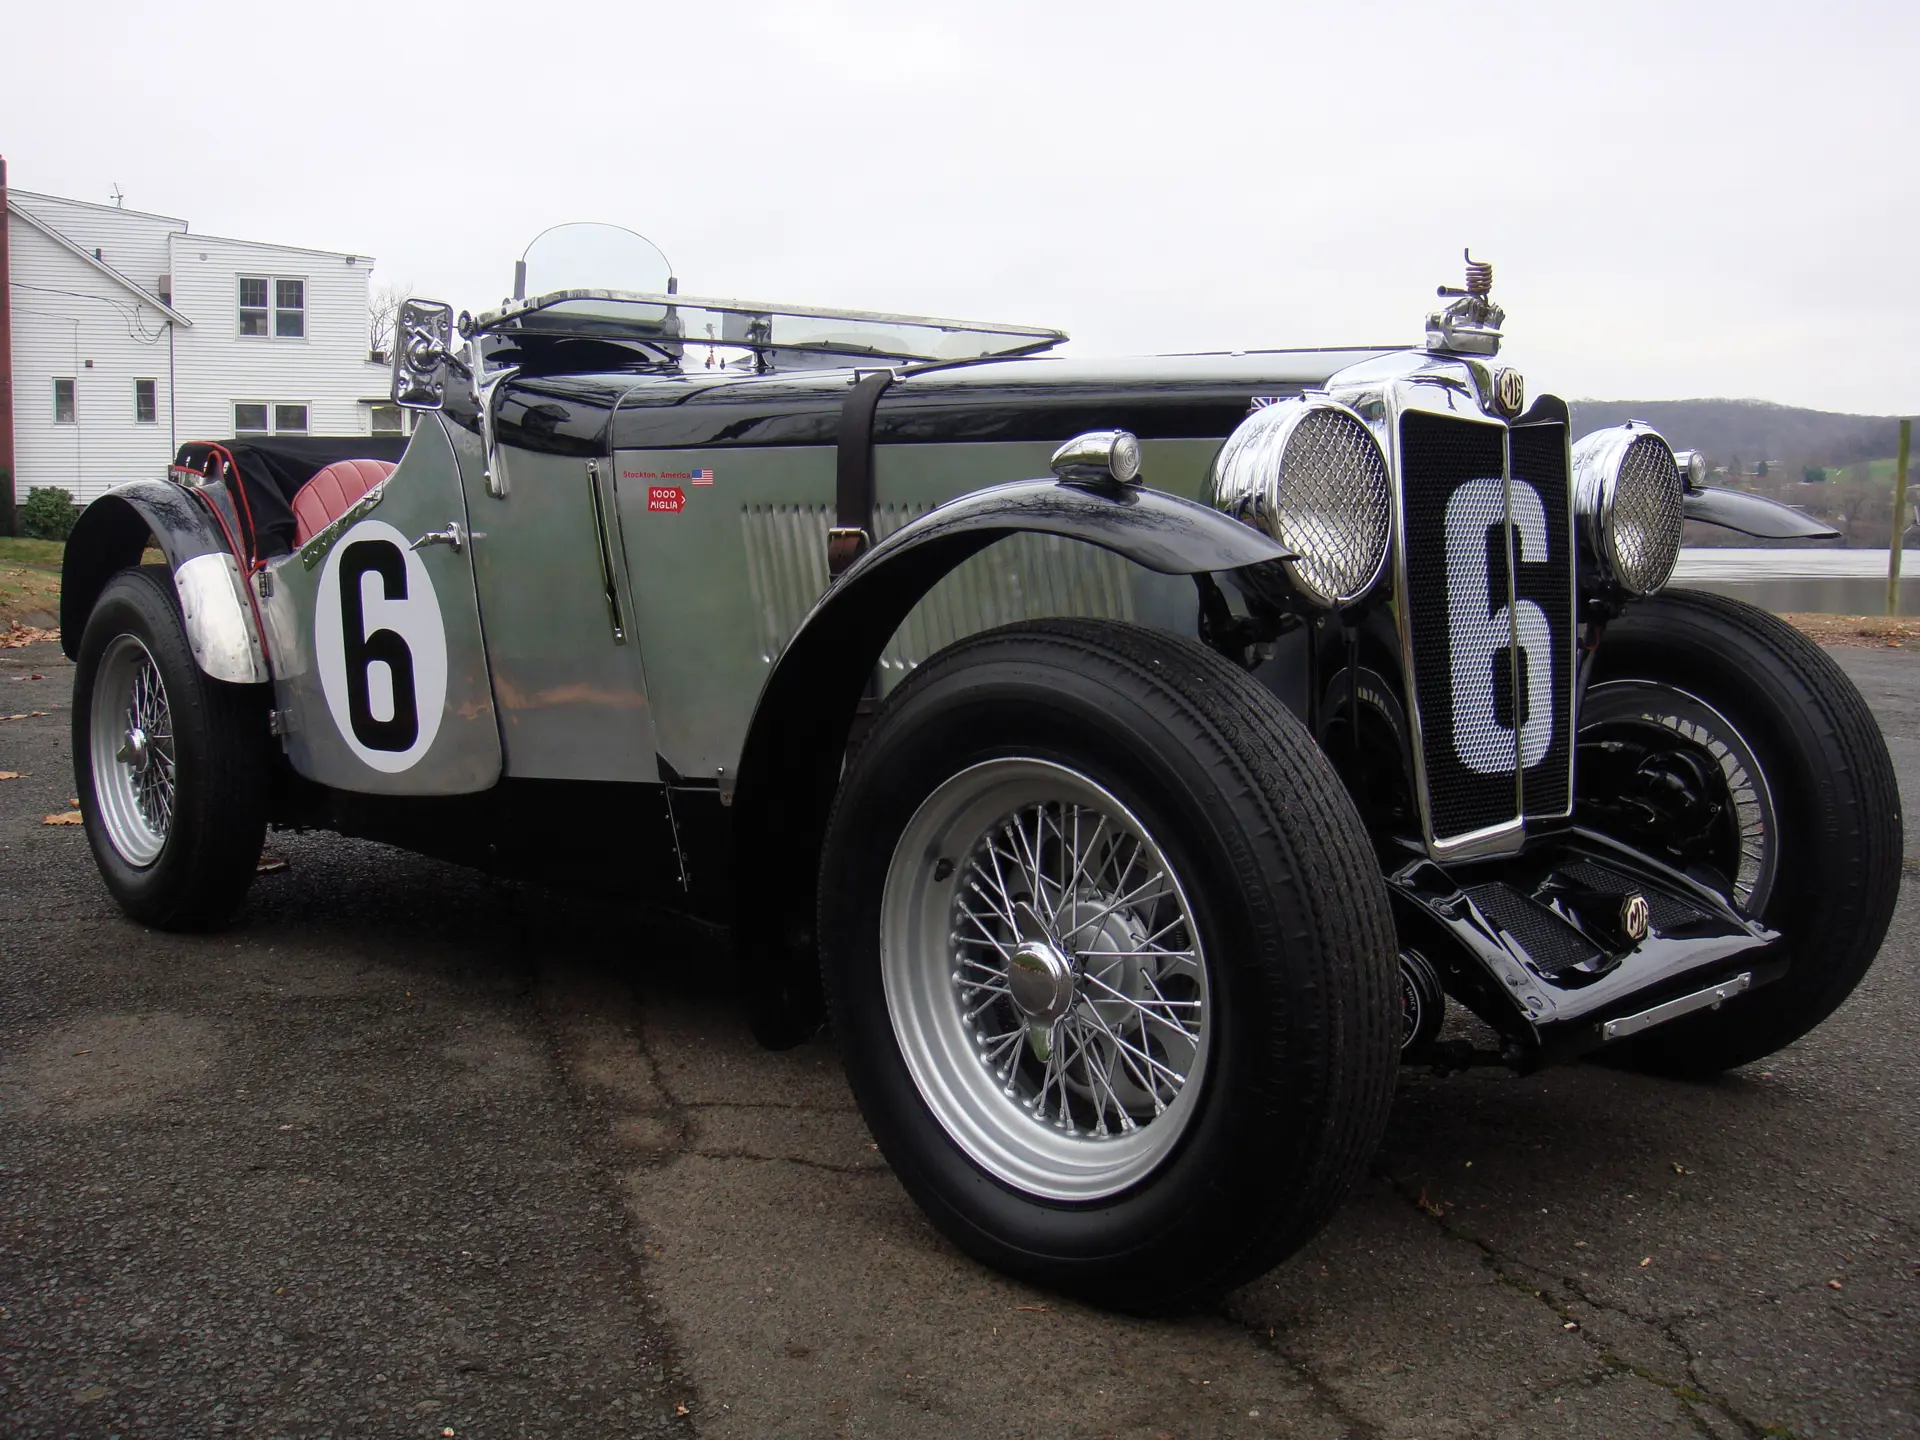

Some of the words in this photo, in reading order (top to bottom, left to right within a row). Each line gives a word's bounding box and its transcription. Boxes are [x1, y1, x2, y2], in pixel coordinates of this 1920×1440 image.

[1499, 368, 1523, 410] MG
[623, 470, 658, 479] Stockton,
[652, 490, 676, 499] 1000
[650, 501, 678, 510] MIGLIA
[339, 539, 419, 752] 6
[1444, 478, 1552, 774] 6
[1626, 897, 1648, 939] MG
